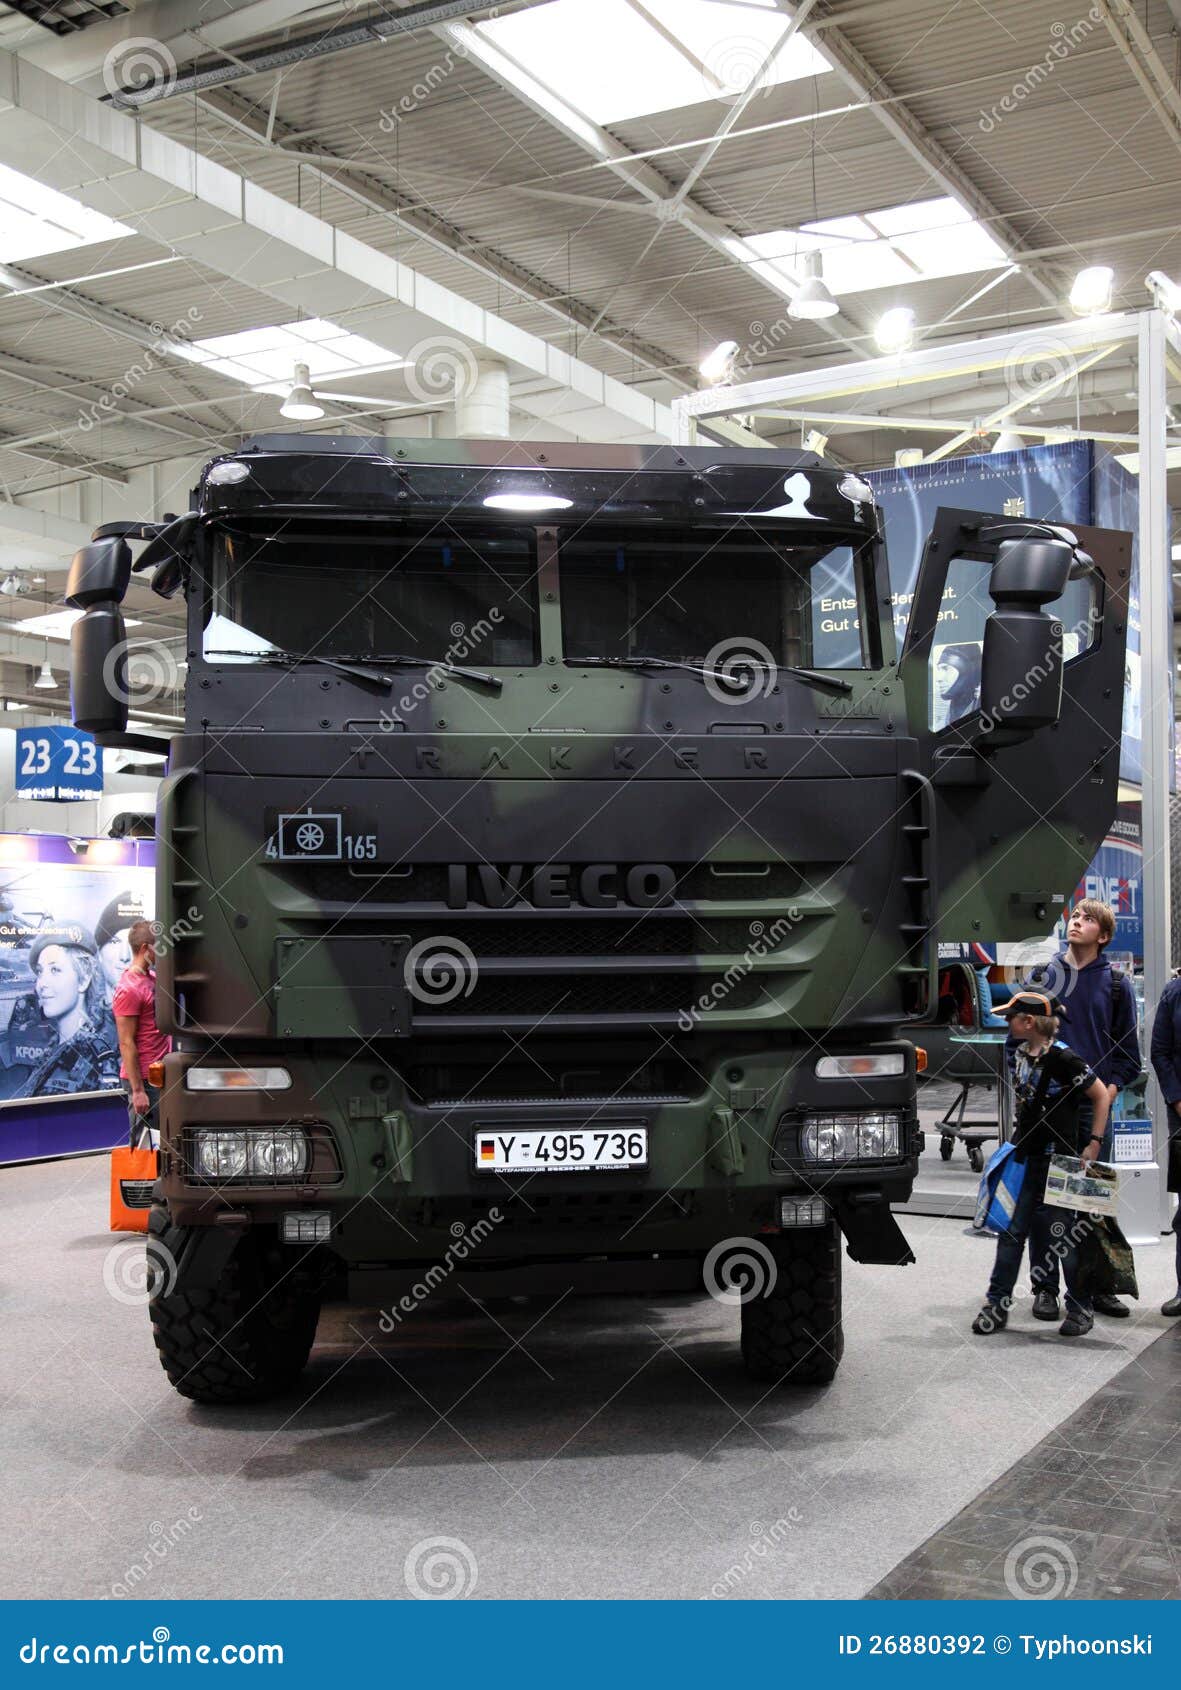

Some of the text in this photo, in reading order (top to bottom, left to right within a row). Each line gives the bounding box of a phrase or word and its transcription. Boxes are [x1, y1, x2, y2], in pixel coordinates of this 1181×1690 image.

[821, 618, 849, 632] Gut
[21, 738, 97, 775] 23 23
[350, 745, 769, 770] TRAKKER
[265, 835, 377, 859] 4 165
[447, 864, 677, 910] IVECO
[593, 1133, 642, 1160] 736
